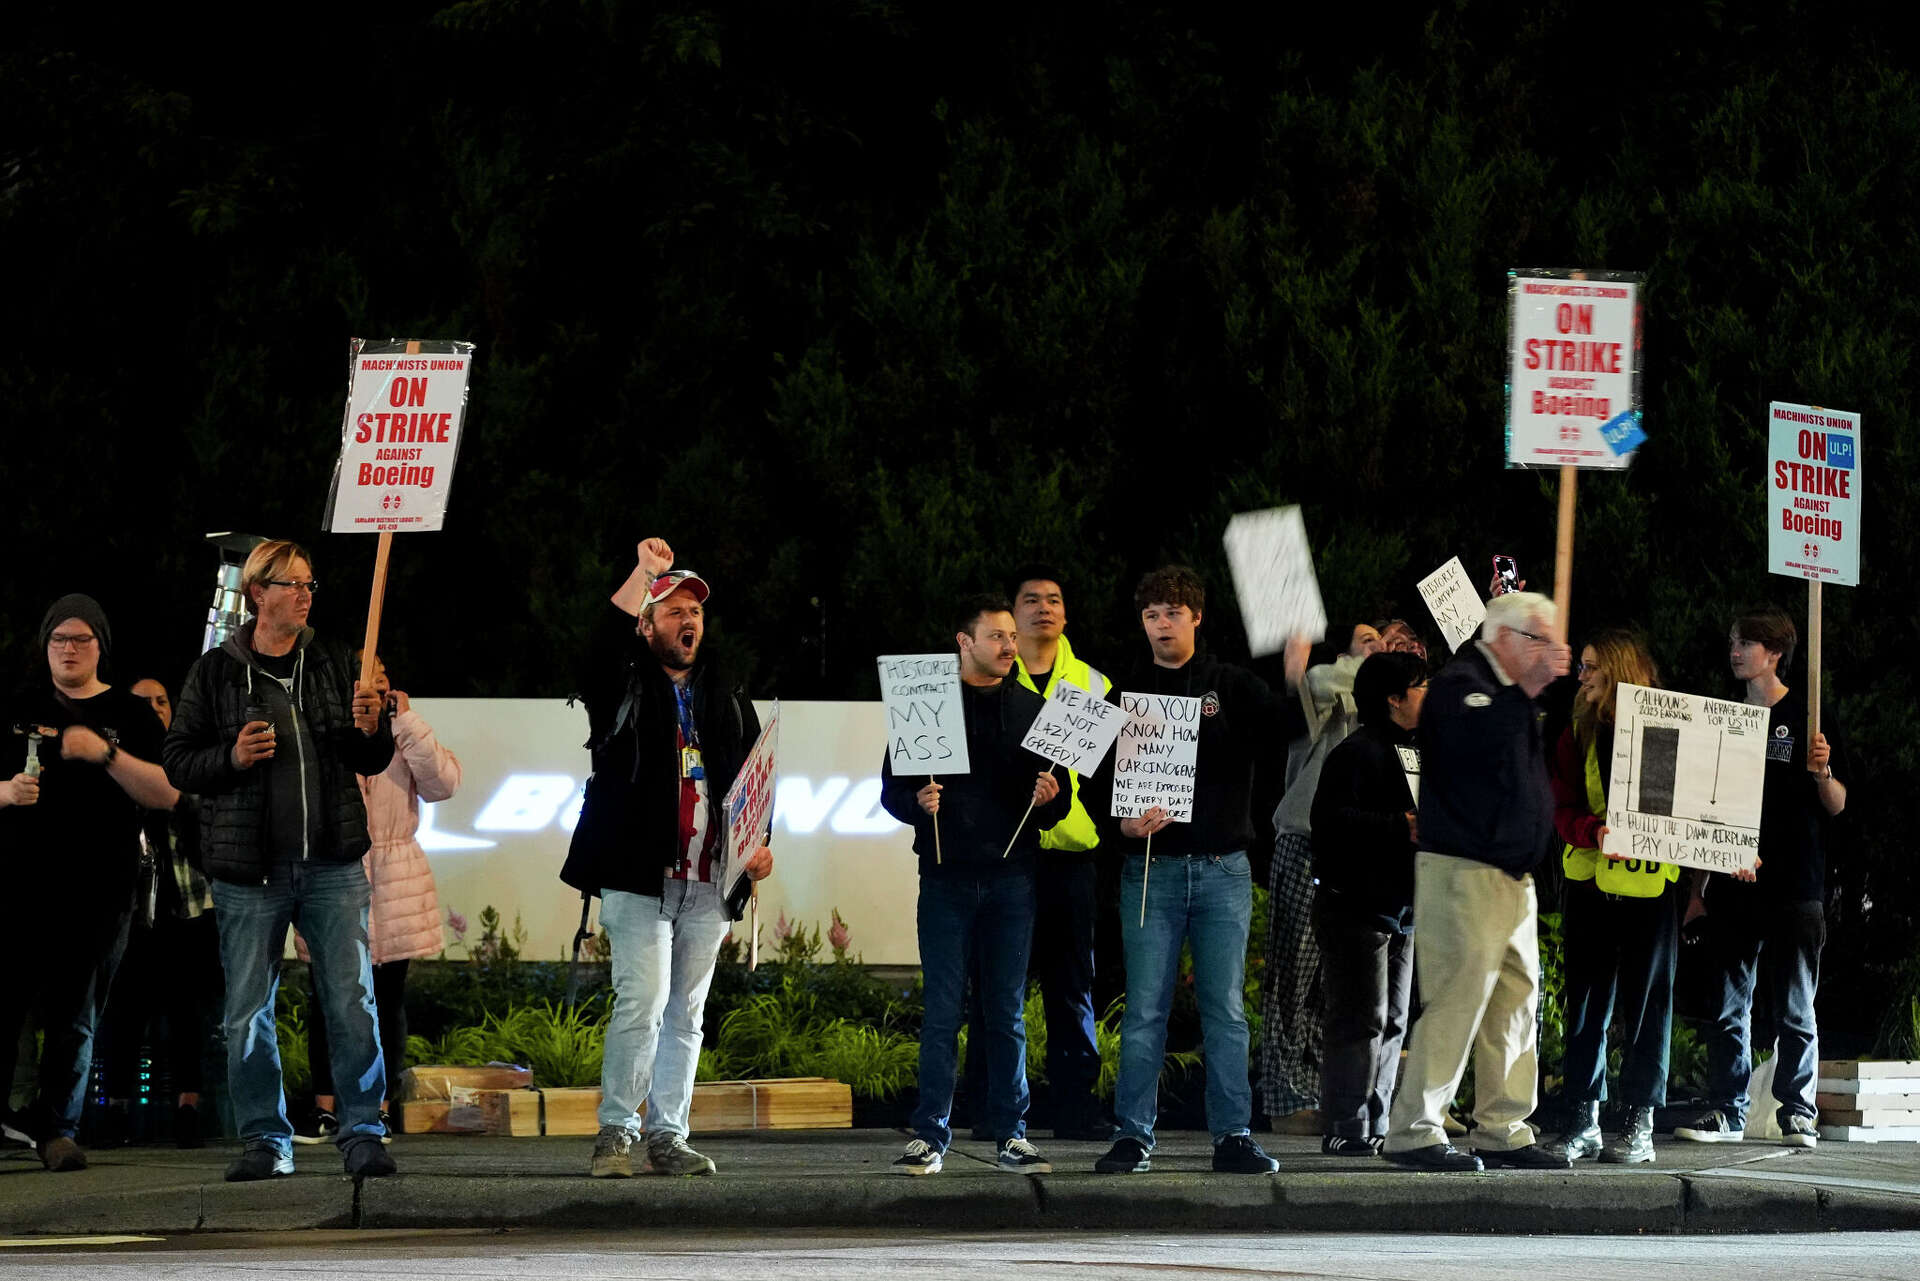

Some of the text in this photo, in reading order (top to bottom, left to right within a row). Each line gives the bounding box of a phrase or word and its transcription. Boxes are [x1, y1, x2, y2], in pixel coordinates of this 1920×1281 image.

[1556, 303, 1594, 335] ON
[362, 360, 464, 370] MACHINISTS UNION
[1525, 338, 1622, 373] STRIKE
[390, 377, 428, 407] ON
[356, 413, 452, 444] STRIKE
[1774, 408, 1852, 430] MACHINISTS UNION
[376, 448, 422, 460] AGAINST
[1798, 430, 1826, 462] ON
[1830, 441, 1852, 457] ULP!
[358, 462, 434, 488] Boeing
[1775, 460, 1850, 499] STRIKE
[1794, 497, 1830, 512] AGAINST
[1782, 508, 1842, 541] Boeing
[1421, 566, 1457, 598] HISTORIC
[1430, 580, 1461, 610] CONTRACT
[1436, 603, 1459, 627] MY
[1455, 615, 1478, 639] ASS
[892, 681, 954, 696] CONTRACT
[1056, 683, 1112, 719] WE ARE
[1123, 696, 1197, 722] DO YOU
[1704, 700, 1765, 720] AVERAGE SALARY
[890, 700, 944, 729] MY
[1064, 713, 1098, 733] NOT
[1639, 706, 1692, 722] 2023 EARNINGS
[1708, 716, 1723, 725] FOR
[1728, 718, 1742, 728] US
[1034, 717, 1096, 752] LAZY OR
[1121, 721, 1198, 742] KNOW HOW
[894, 735, 952, 760] ASS
[1026, 736, 1080, 766] GREEDY
[1137, 743, 1174, 758] MANY
[1117, 759, 1196, 778] CARCINOGENS
[1115, 778, 1192, 792] WE ARE EXPOSED
[1115, 794, 1128, 802] TO
[1135, 795, 1162, 804] EVERY
[1116, 805, 1133, 817] PAY
[1628, 813, 1658, 833] BUILD
[1664, 819, 1680, 836] THE
[1632, 834, 1742, 868] PAY US MORE!!!
